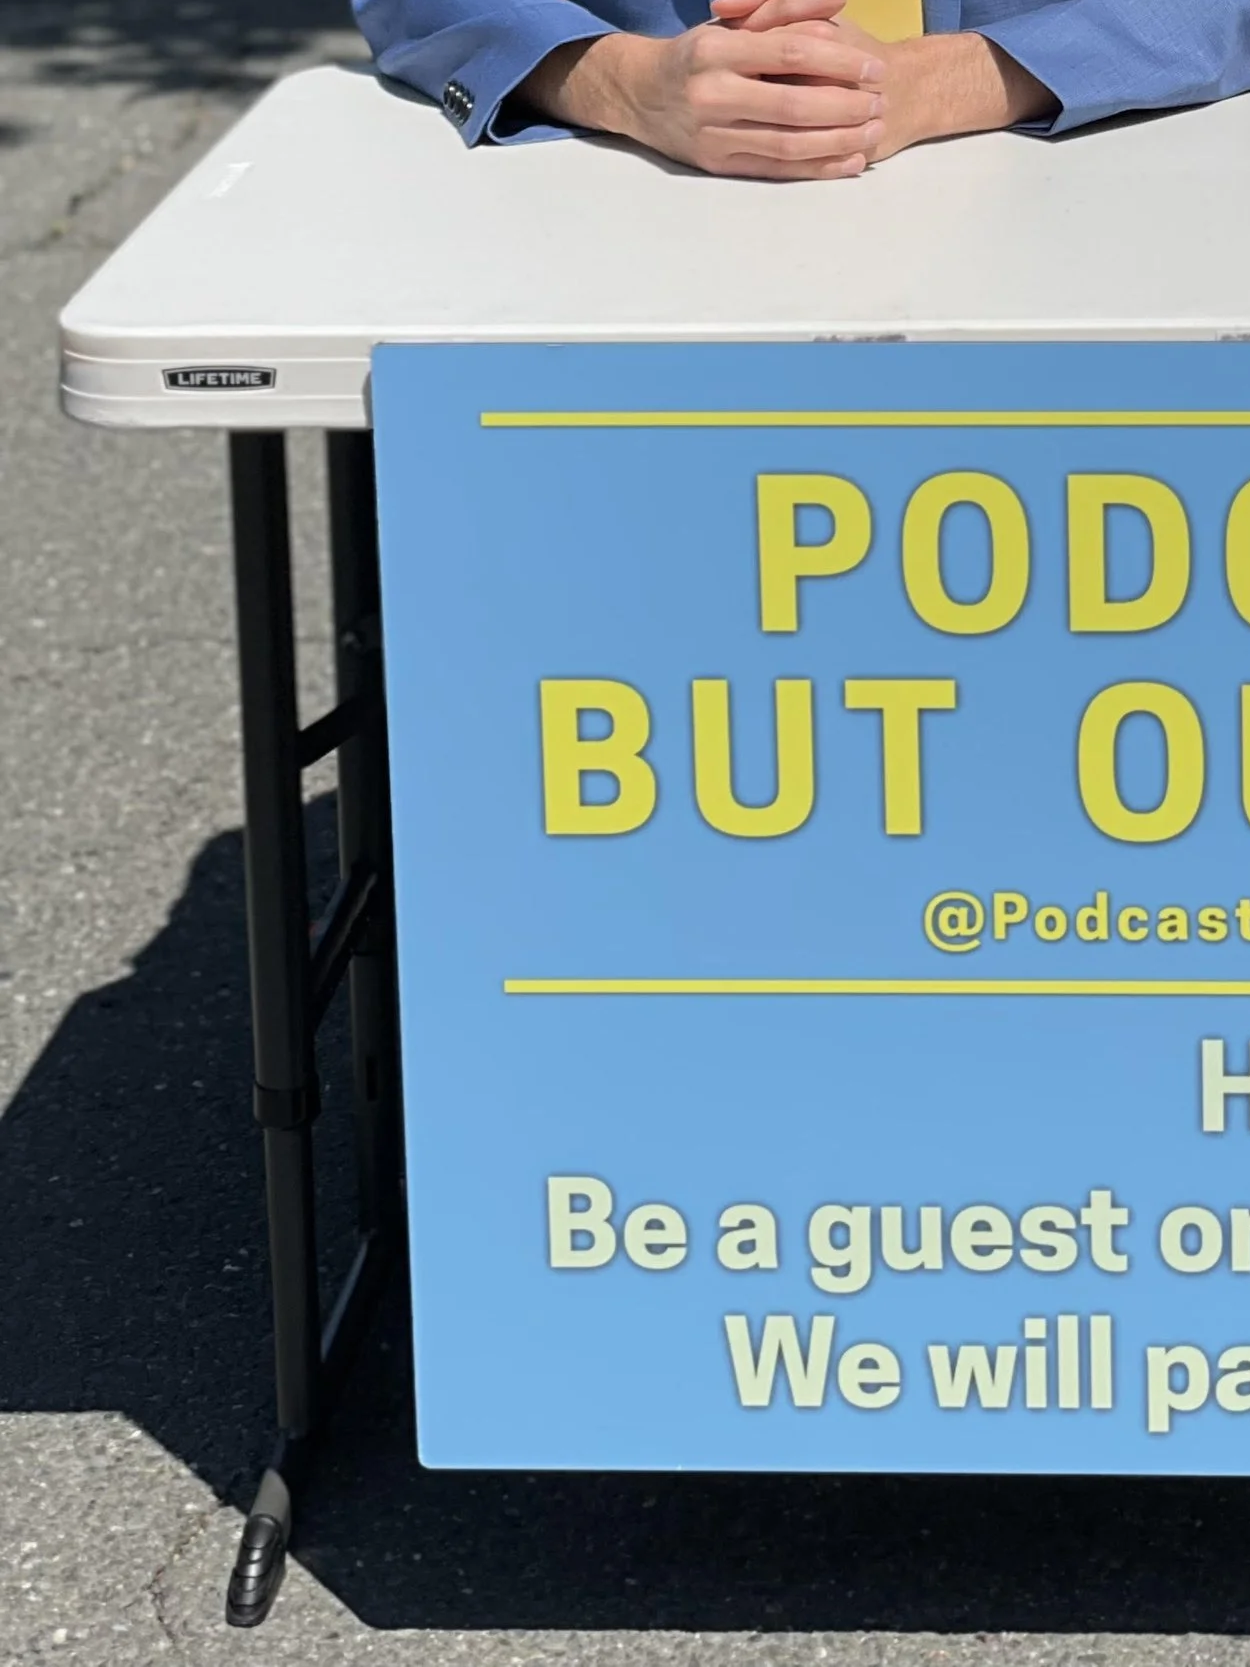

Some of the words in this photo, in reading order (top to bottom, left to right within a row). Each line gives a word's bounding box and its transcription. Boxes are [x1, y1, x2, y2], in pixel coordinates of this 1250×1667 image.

[177, 372, 262, 386] LIFETIME
[539, 678, 957, 838] BUT
[546, 1175, 688, 1271] Be
[716, 1203, 779, 1271] a
[807, 1189, 1130, 1294] guest
[723, 1314, 902, 1410] We
[926, 1313, 1113, 1410] will
